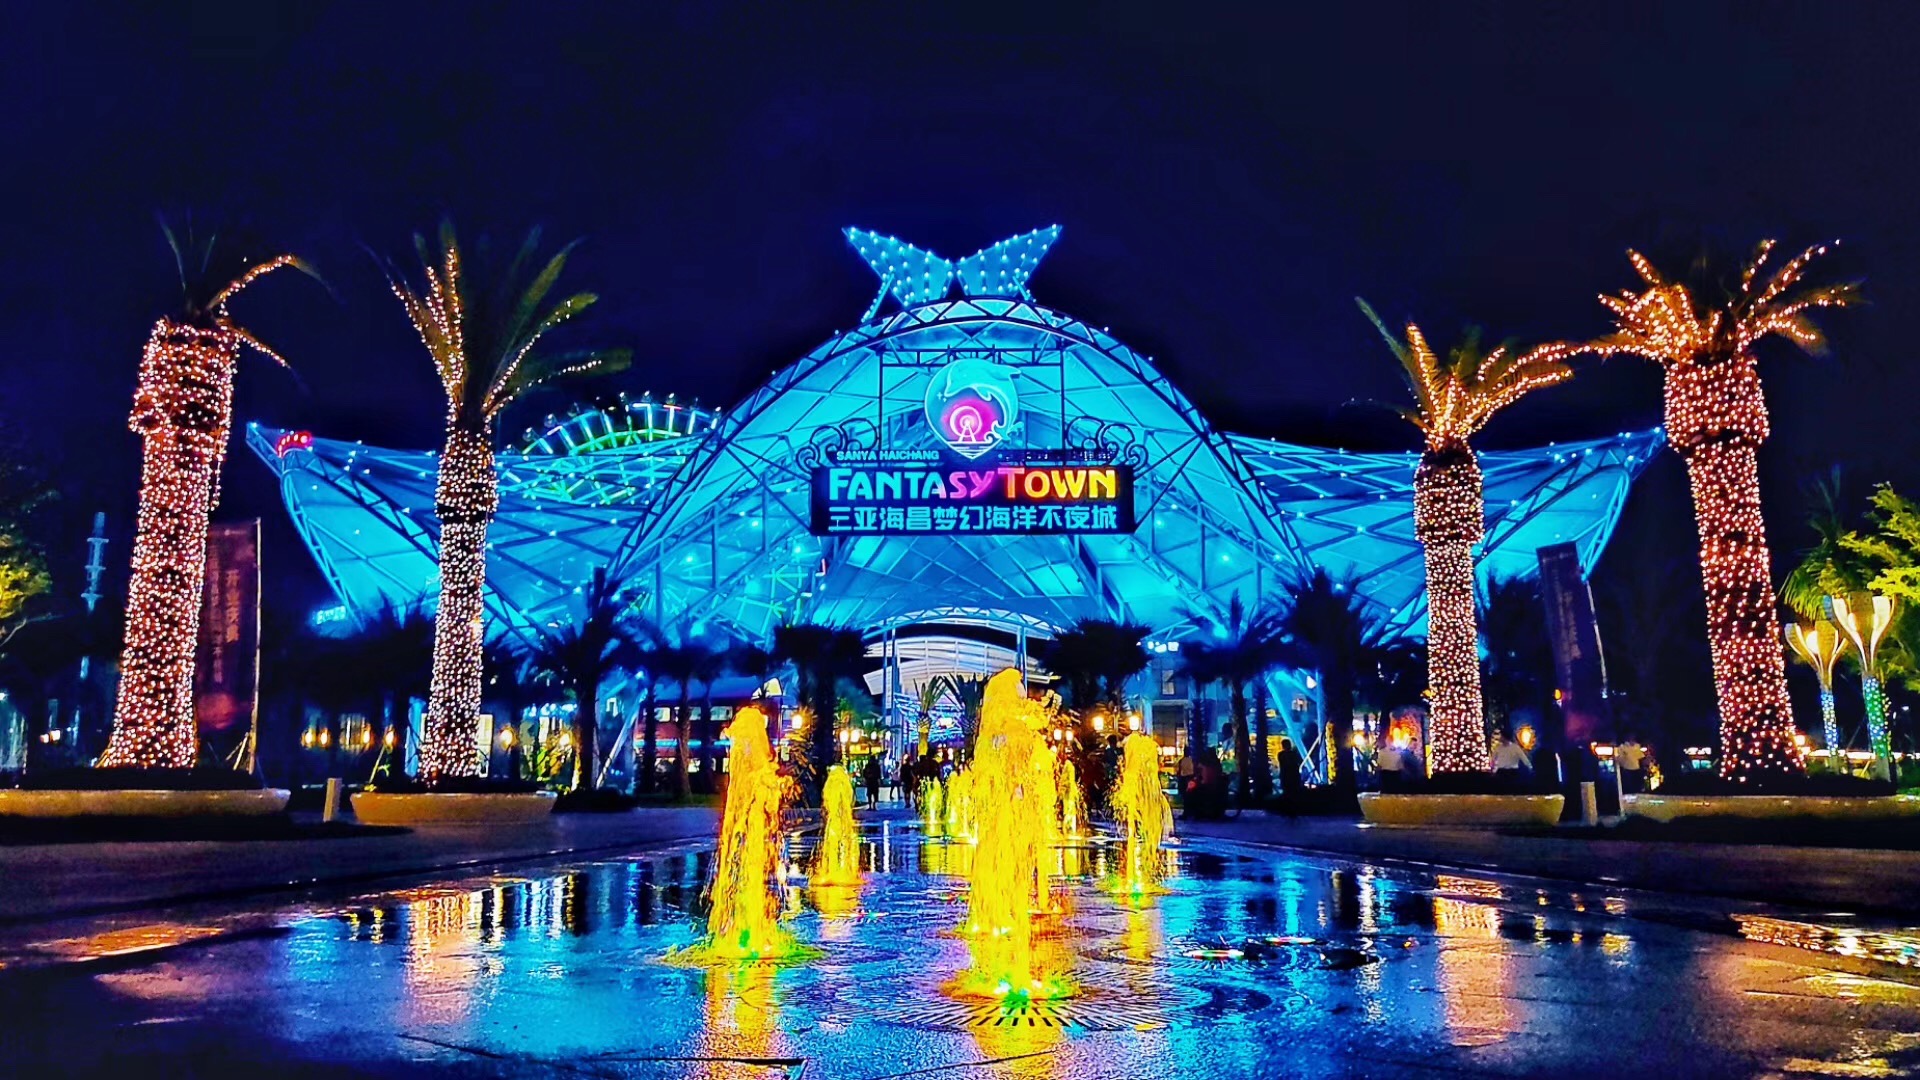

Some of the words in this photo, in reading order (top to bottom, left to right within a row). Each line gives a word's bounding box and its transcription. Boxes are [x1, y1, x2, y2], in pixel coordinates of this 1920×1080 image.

[836, 450, 877, 461] SANYA
[879, 450, 940, 460] HAICHANG
[829, 468, 995, 500] FANTASY
[998, 467, 1116, 499] TOWN
[828, 505, 1117, 530] 三亚海昌梦幻海洋不夜城
